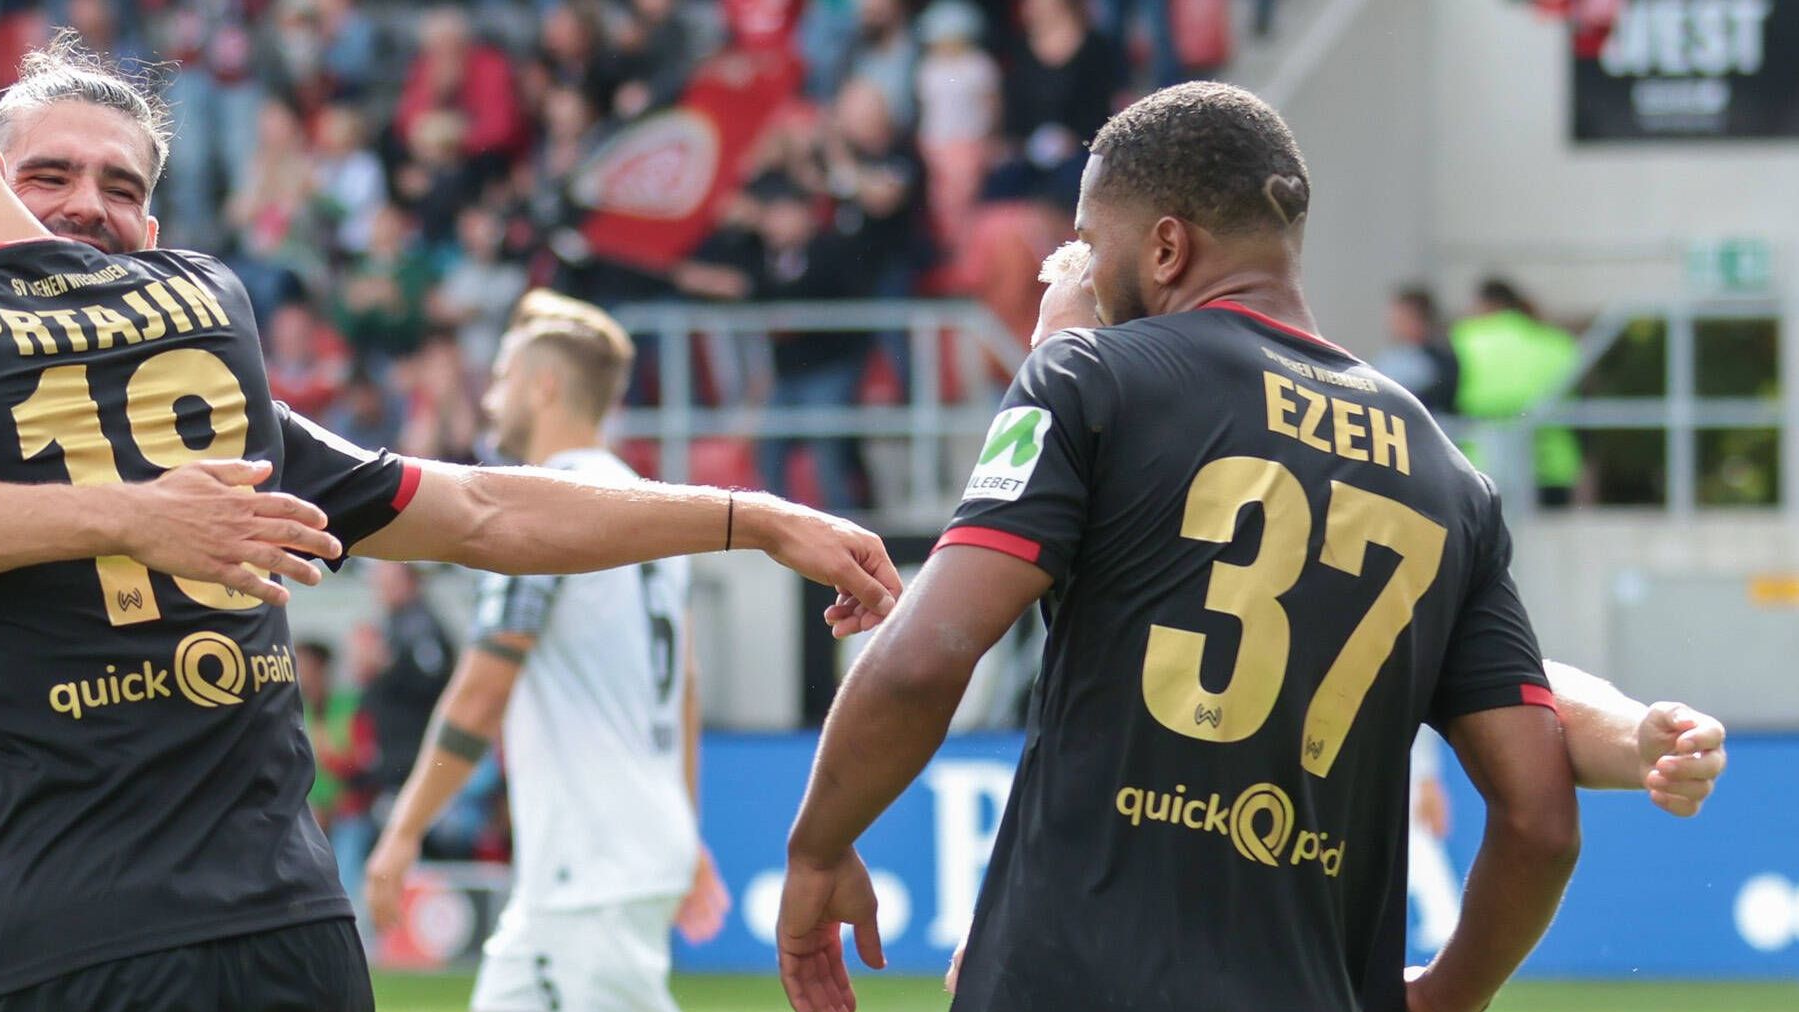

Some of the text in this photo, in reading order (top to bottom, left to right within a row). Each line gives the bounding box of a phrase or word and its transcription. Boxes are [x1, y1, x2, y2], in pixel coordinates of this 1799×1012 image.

[1263, 370, 1411, 476] EZEH
[1142, 456, 1448, 779] 37
[50, 660, 171, 719] quick
[251, 644, 296, 692] paid
[1115, 784, 1230, 835] quick
